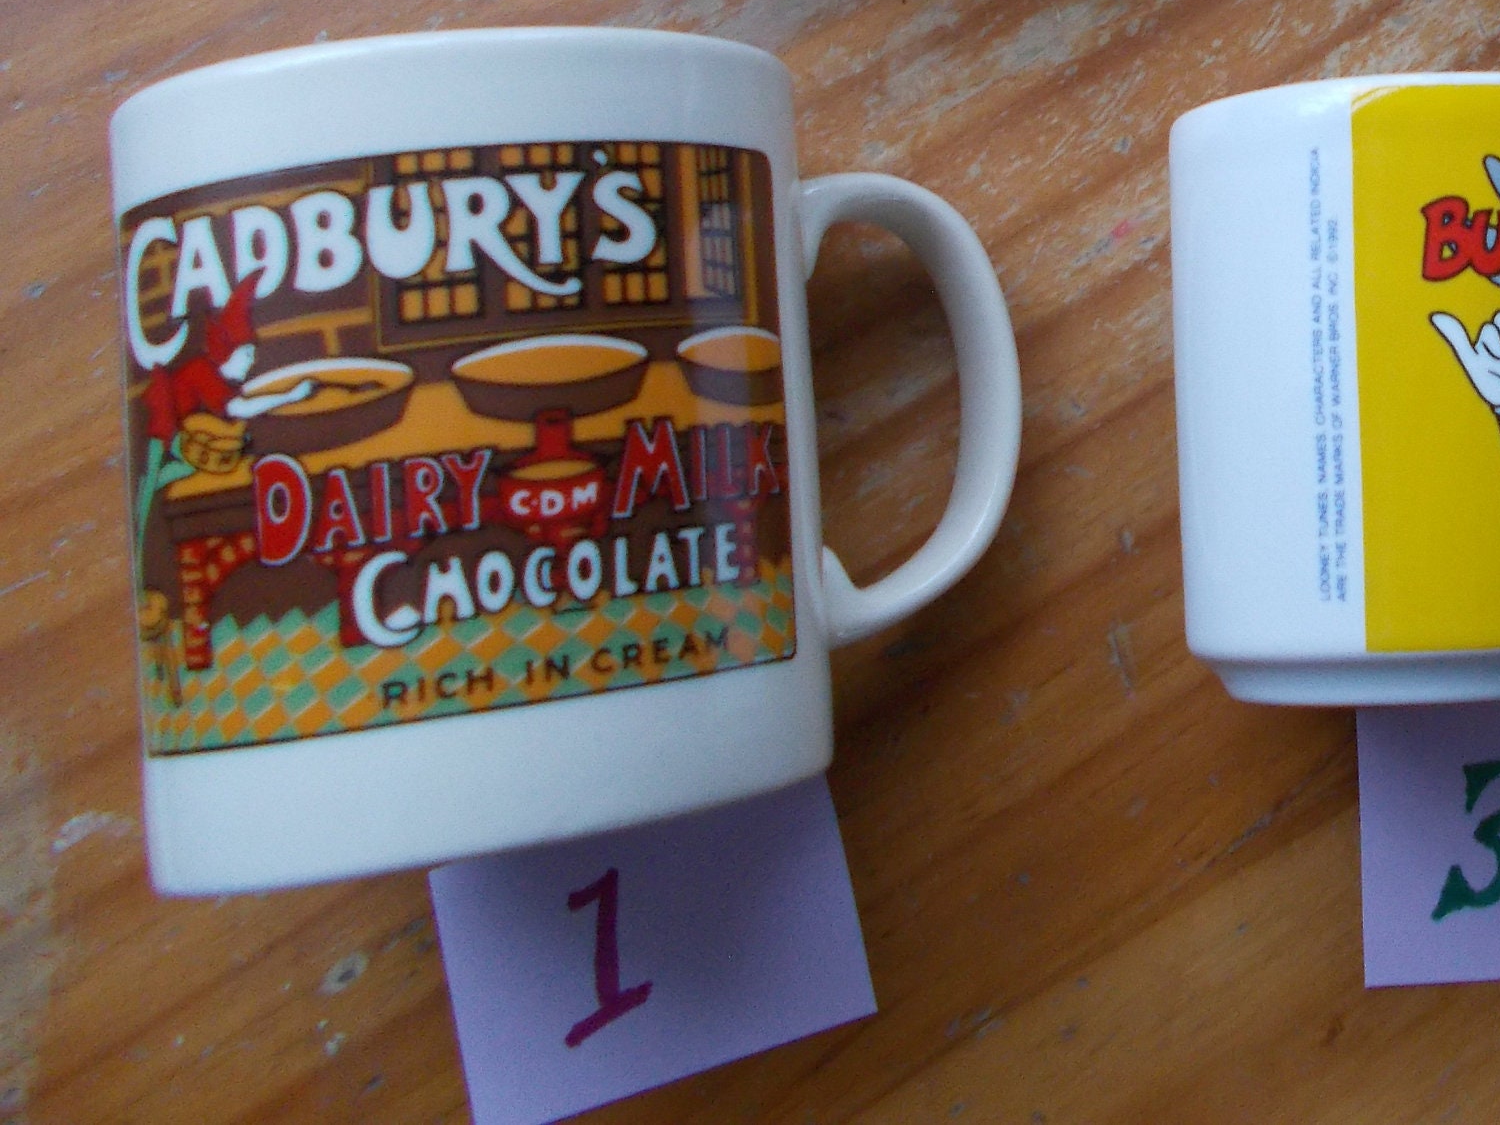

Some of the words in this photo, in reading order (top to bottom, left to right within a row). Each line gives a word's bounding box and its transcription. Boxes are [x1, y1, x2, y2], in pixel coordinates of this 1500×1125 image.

[1310, 199, 1322, 260] RELATED
[128, 149, 656, 370] CADBURY'S
[1311, 267, 1322, 290] ALL
[1311, 295, 1323, 323] AND
[1312, 330, 1326, 426] CHARACTERS
[1329, 346, 1342, 406] WARNER
[1331, 413, 1343, 430] OF
[1332, 435, 1344, 484] MARKS
[252, 448, 494, 568] DAIRY
[611, 418, 781, 519] MILK
[1333, 490, 1345, 535] TRADE
[1317, 545, 1331, 602] LOONEY
[1335, 542, 1346, 567] THE
[352, 522, 741, 648] CHOCOLATE
[1335, 575, 1347, 602] ARE
[382, 667, 494, 709] RICH
[525, 654, 570, 685] IN
[591, 626, 728, 675] CREAM
[564, 868, 653, 1048] 1
